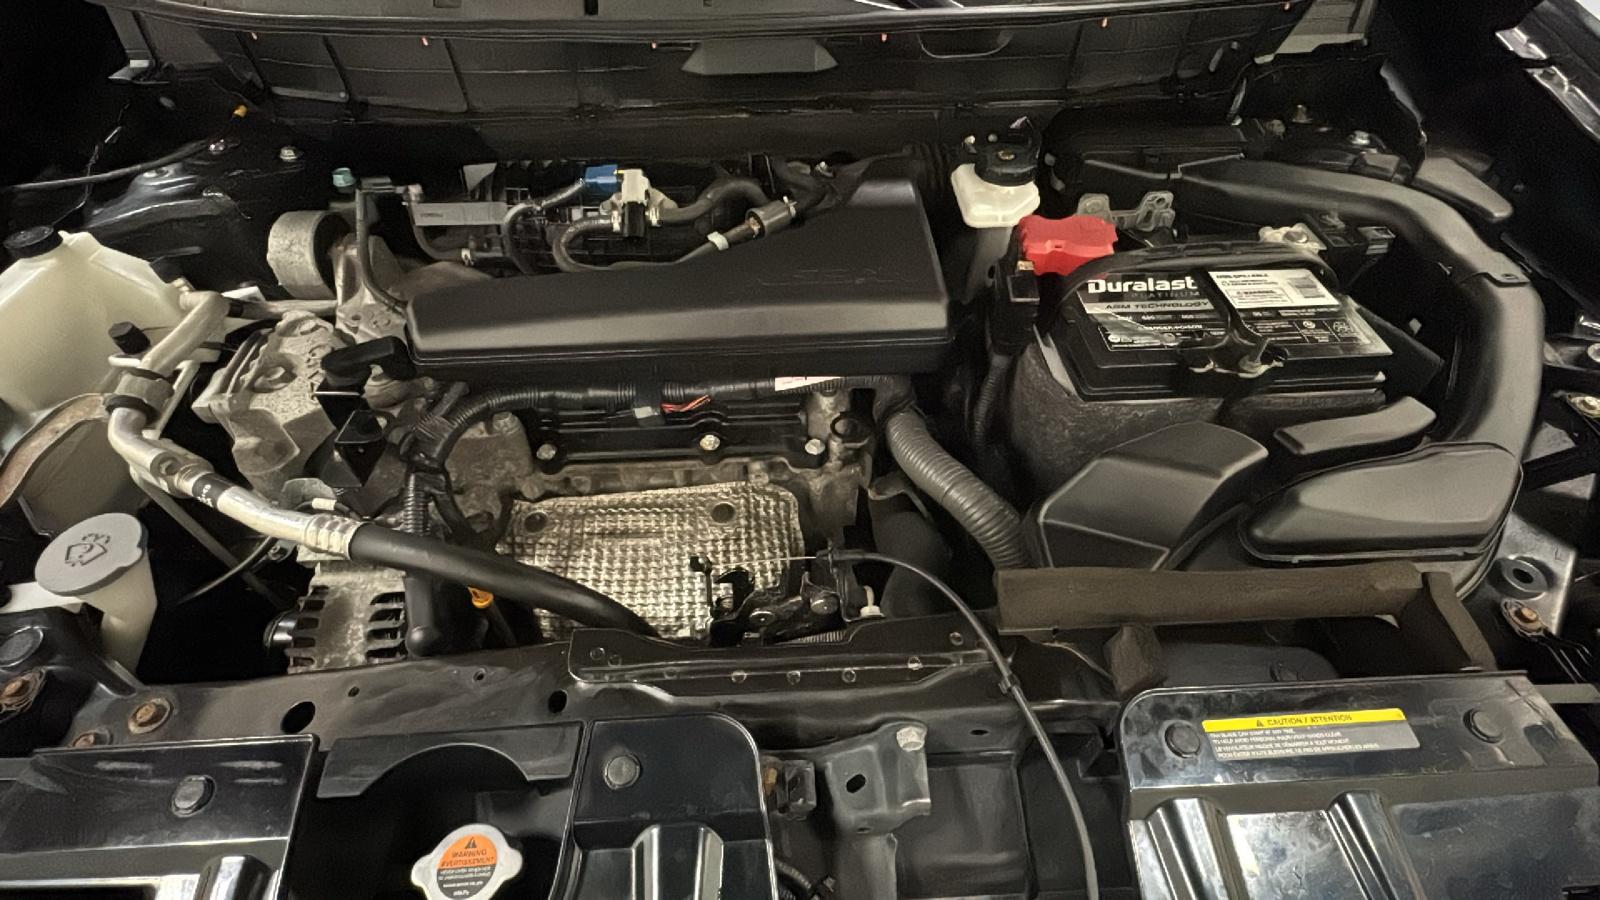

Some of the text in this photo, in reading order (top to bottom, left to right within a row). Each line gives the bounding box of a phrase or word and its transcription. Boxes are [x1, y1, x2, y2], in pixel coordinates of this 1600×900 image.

[1087, 276, 1198, 294] Duralast
[1130, 290, 1201, 299] PLATINUM
[1134, 301, 1209, 309] TECHNOLOGY
[1267, 716, 1303, 726] CAUTION
[1310, 714, 1353, 723] ATTENTION
